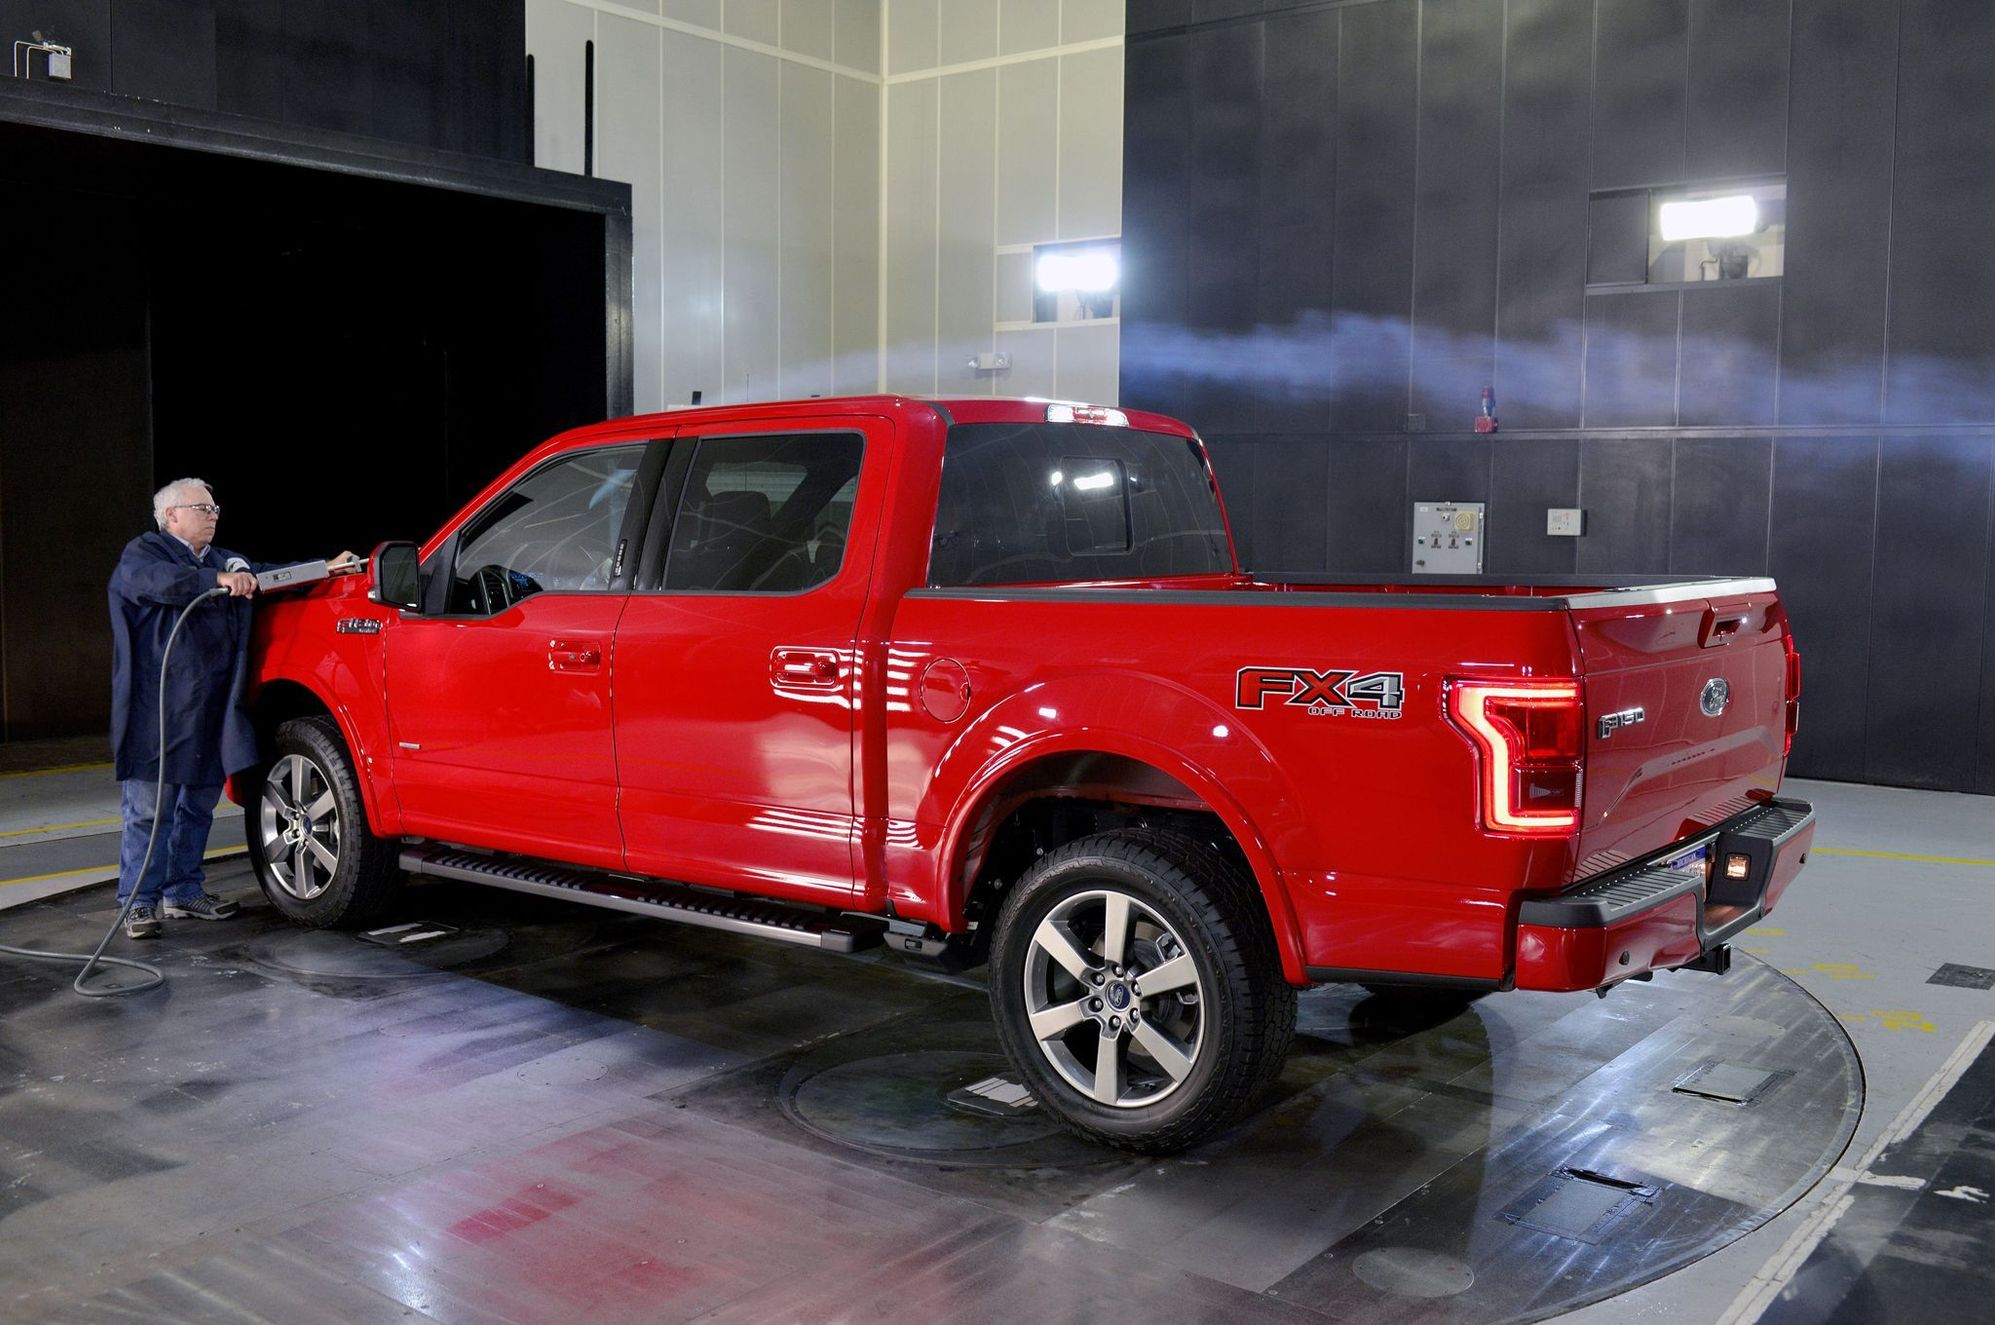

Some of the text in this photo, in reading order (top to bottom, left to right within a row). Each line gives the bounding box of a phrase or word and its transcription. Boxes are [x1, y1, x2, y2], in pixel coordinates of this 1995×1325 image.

[1235, 666, 1405, 711] FX4
[1307, 706, 1402, 719] OFF ROAD
